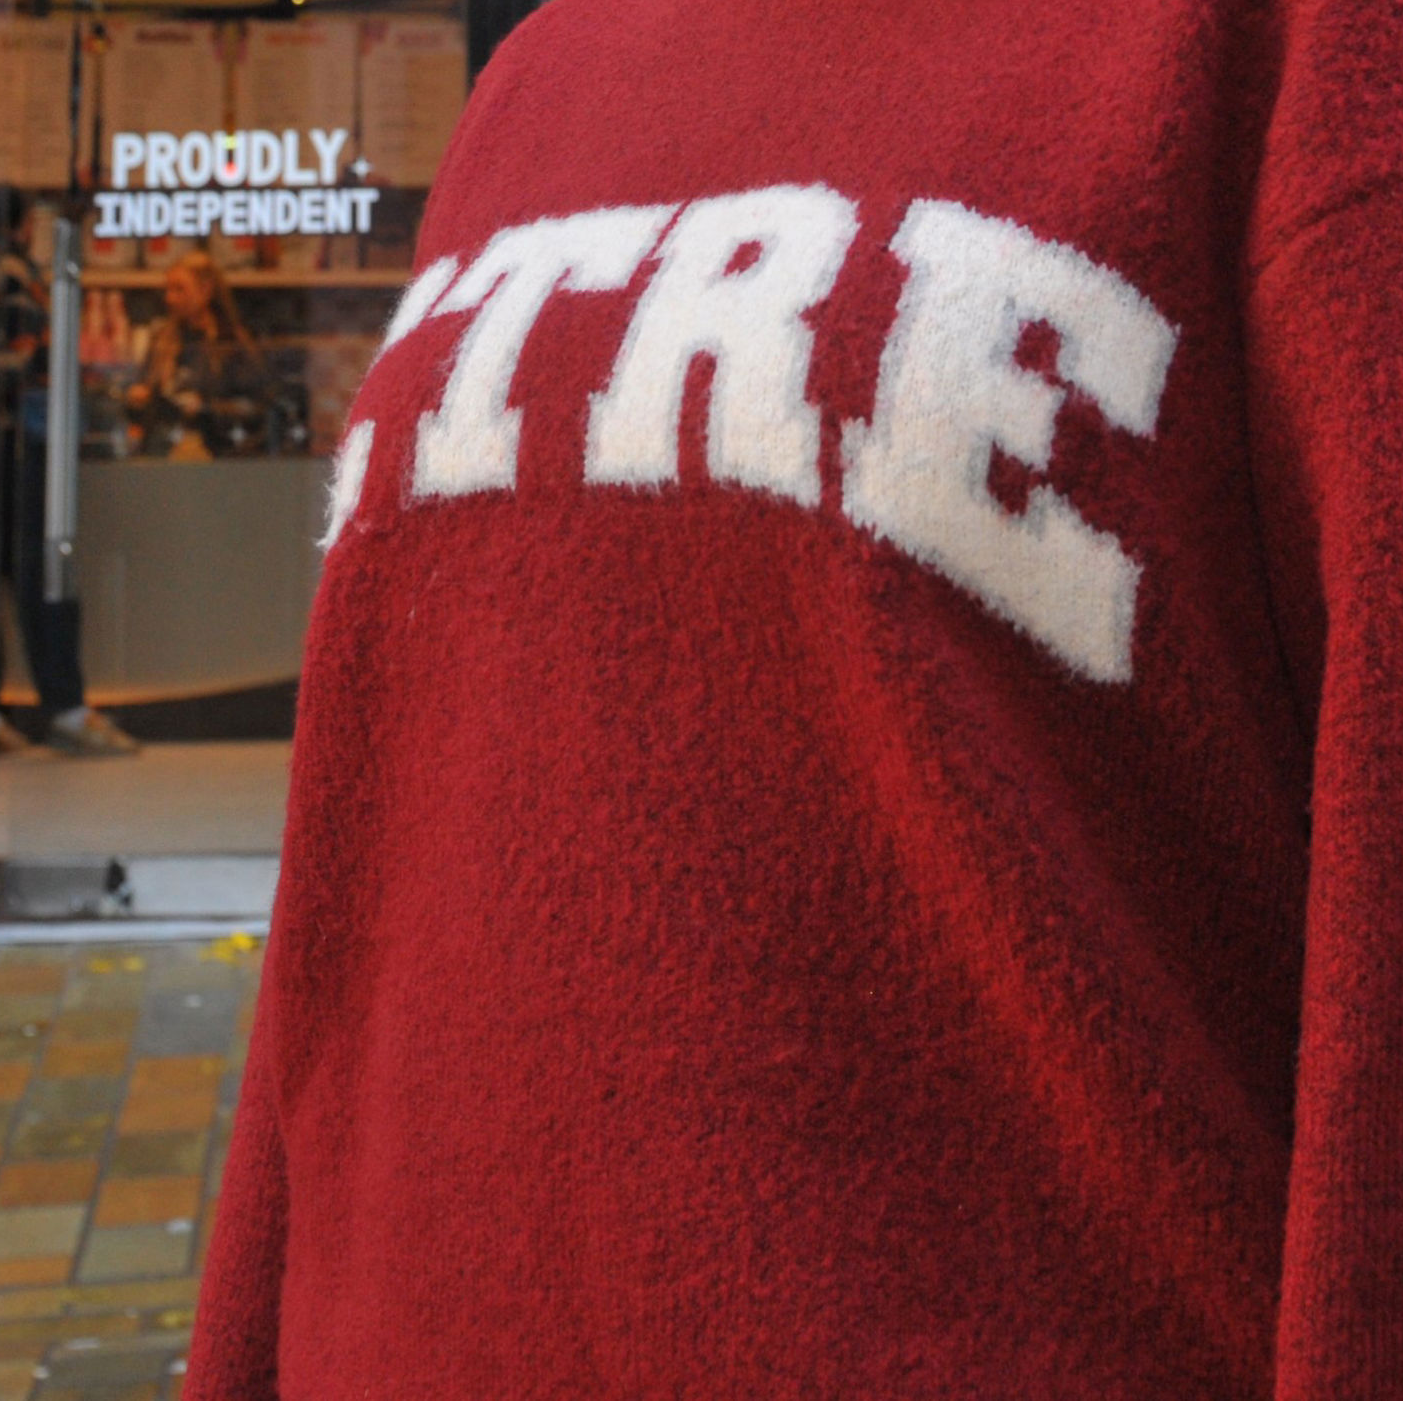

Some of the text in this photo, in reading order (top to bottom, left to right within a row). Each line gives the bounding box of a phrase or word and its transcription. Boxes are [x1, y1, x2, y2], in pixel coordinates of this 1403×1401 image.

[111, 128, 349, 189] PROUDLY
[94, 188, 380, 238] INDEPENDENT
[320, 181, 1181, 684] TRE
